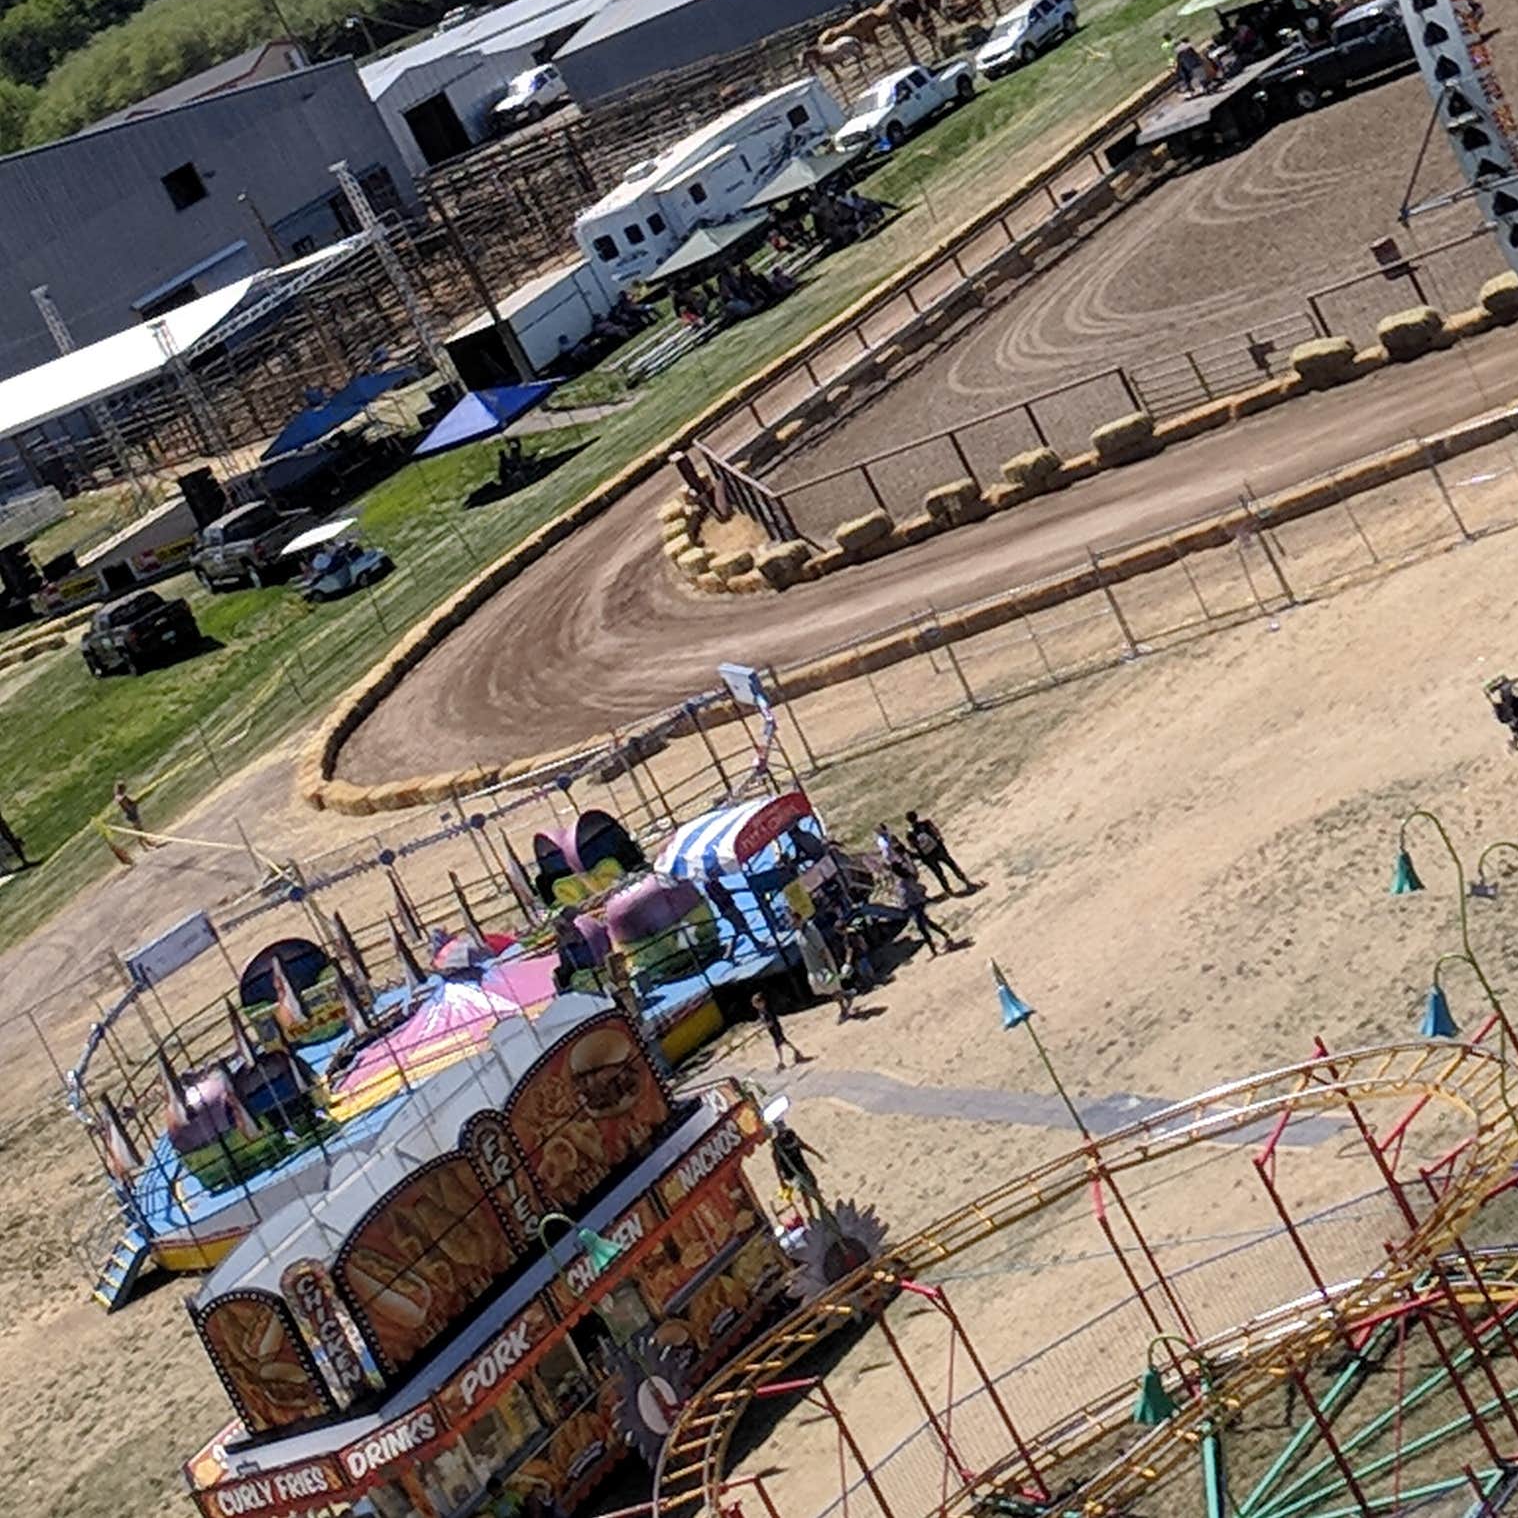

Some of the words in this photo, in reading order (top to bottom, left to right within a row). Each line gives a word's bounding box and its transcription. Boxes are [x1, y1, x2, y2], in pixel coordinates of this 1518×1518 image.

[481, 1134, 542, 1242] FRIES
[678, 1119, 742, 1194] NACHOS
[566, 1212, 644, 1295] CHEN
[296, 1276, 363, 1383] CHICKEN
[459, 1321, 531, 1405] PORK
[347, 1411, 437, 1480] DRINKS
[217, 1479, 274, 1517] CURLY
[274, 1465, 328, 1500] FRIES
